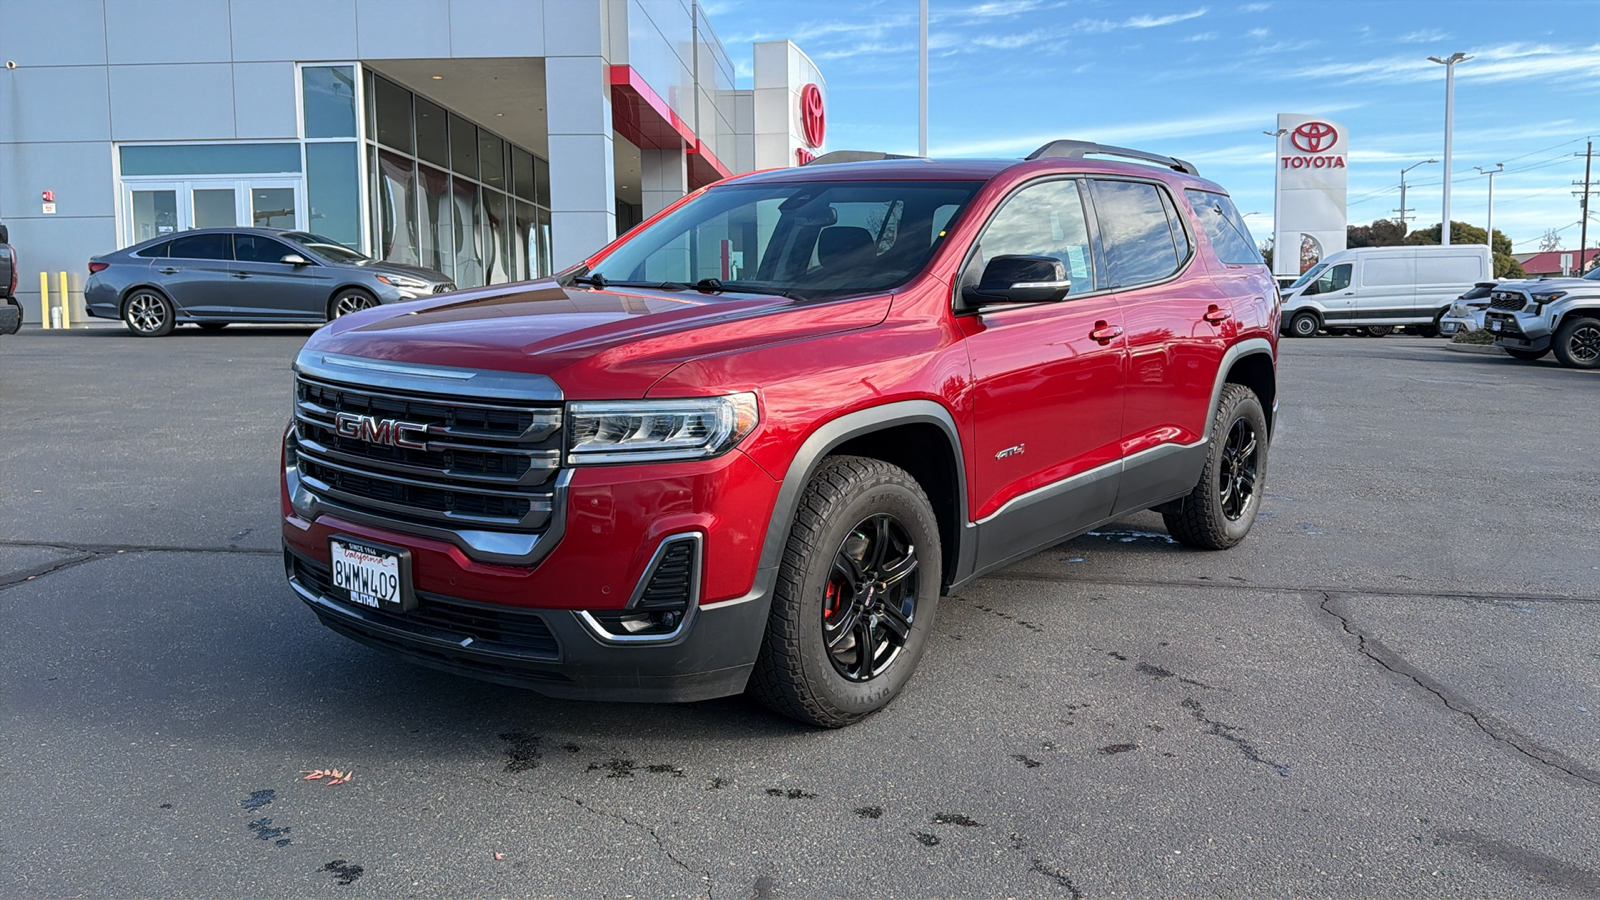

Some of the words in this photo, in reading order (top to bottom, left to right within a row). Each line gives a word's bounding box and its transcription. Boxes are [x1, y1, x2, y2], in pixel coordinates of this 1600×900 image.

[1281, 156, 1346, 169] TOYOTA
[335, 411, 428, 452] GMC
[335, 559, 398, 601] 8WMW409
